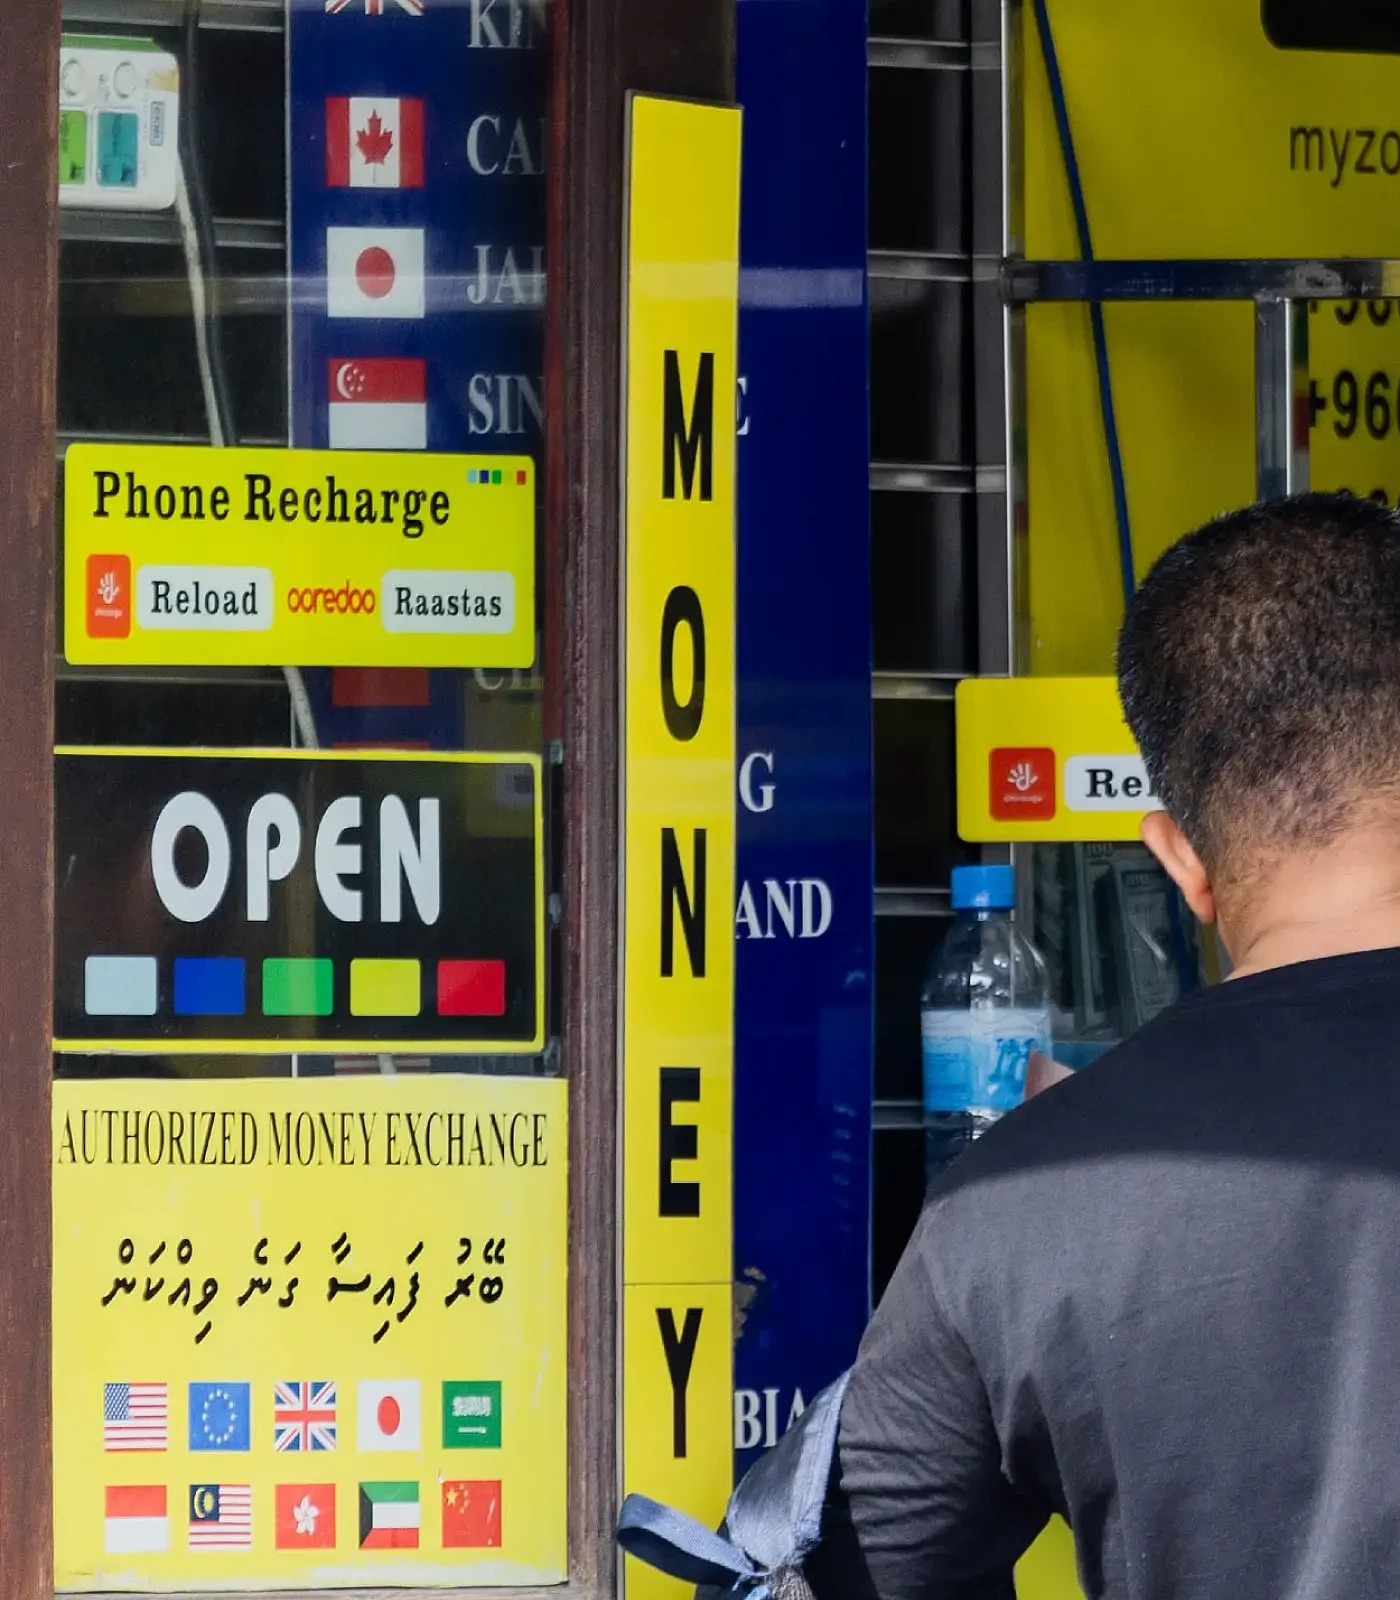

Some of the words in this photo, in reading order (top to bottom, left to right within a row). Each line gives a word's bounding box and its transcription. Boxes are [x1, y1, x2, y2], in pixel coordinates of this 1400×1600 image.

[93, 471, 230, 520] Phone
[244, 474, 450, 538] Recharge
[151, 581, 258, 616] Reload
[287, 580, 375, 615] ooredoo
[395, 587, 502, 617] Raastas
[151, 791, 440, 925] OPEN
[58, 1110, 258, 1165] AUTHORIZED
[268, 1111, 377, 1166] MONEY
[385, 1112, 548, 1167] EXCHANGE
